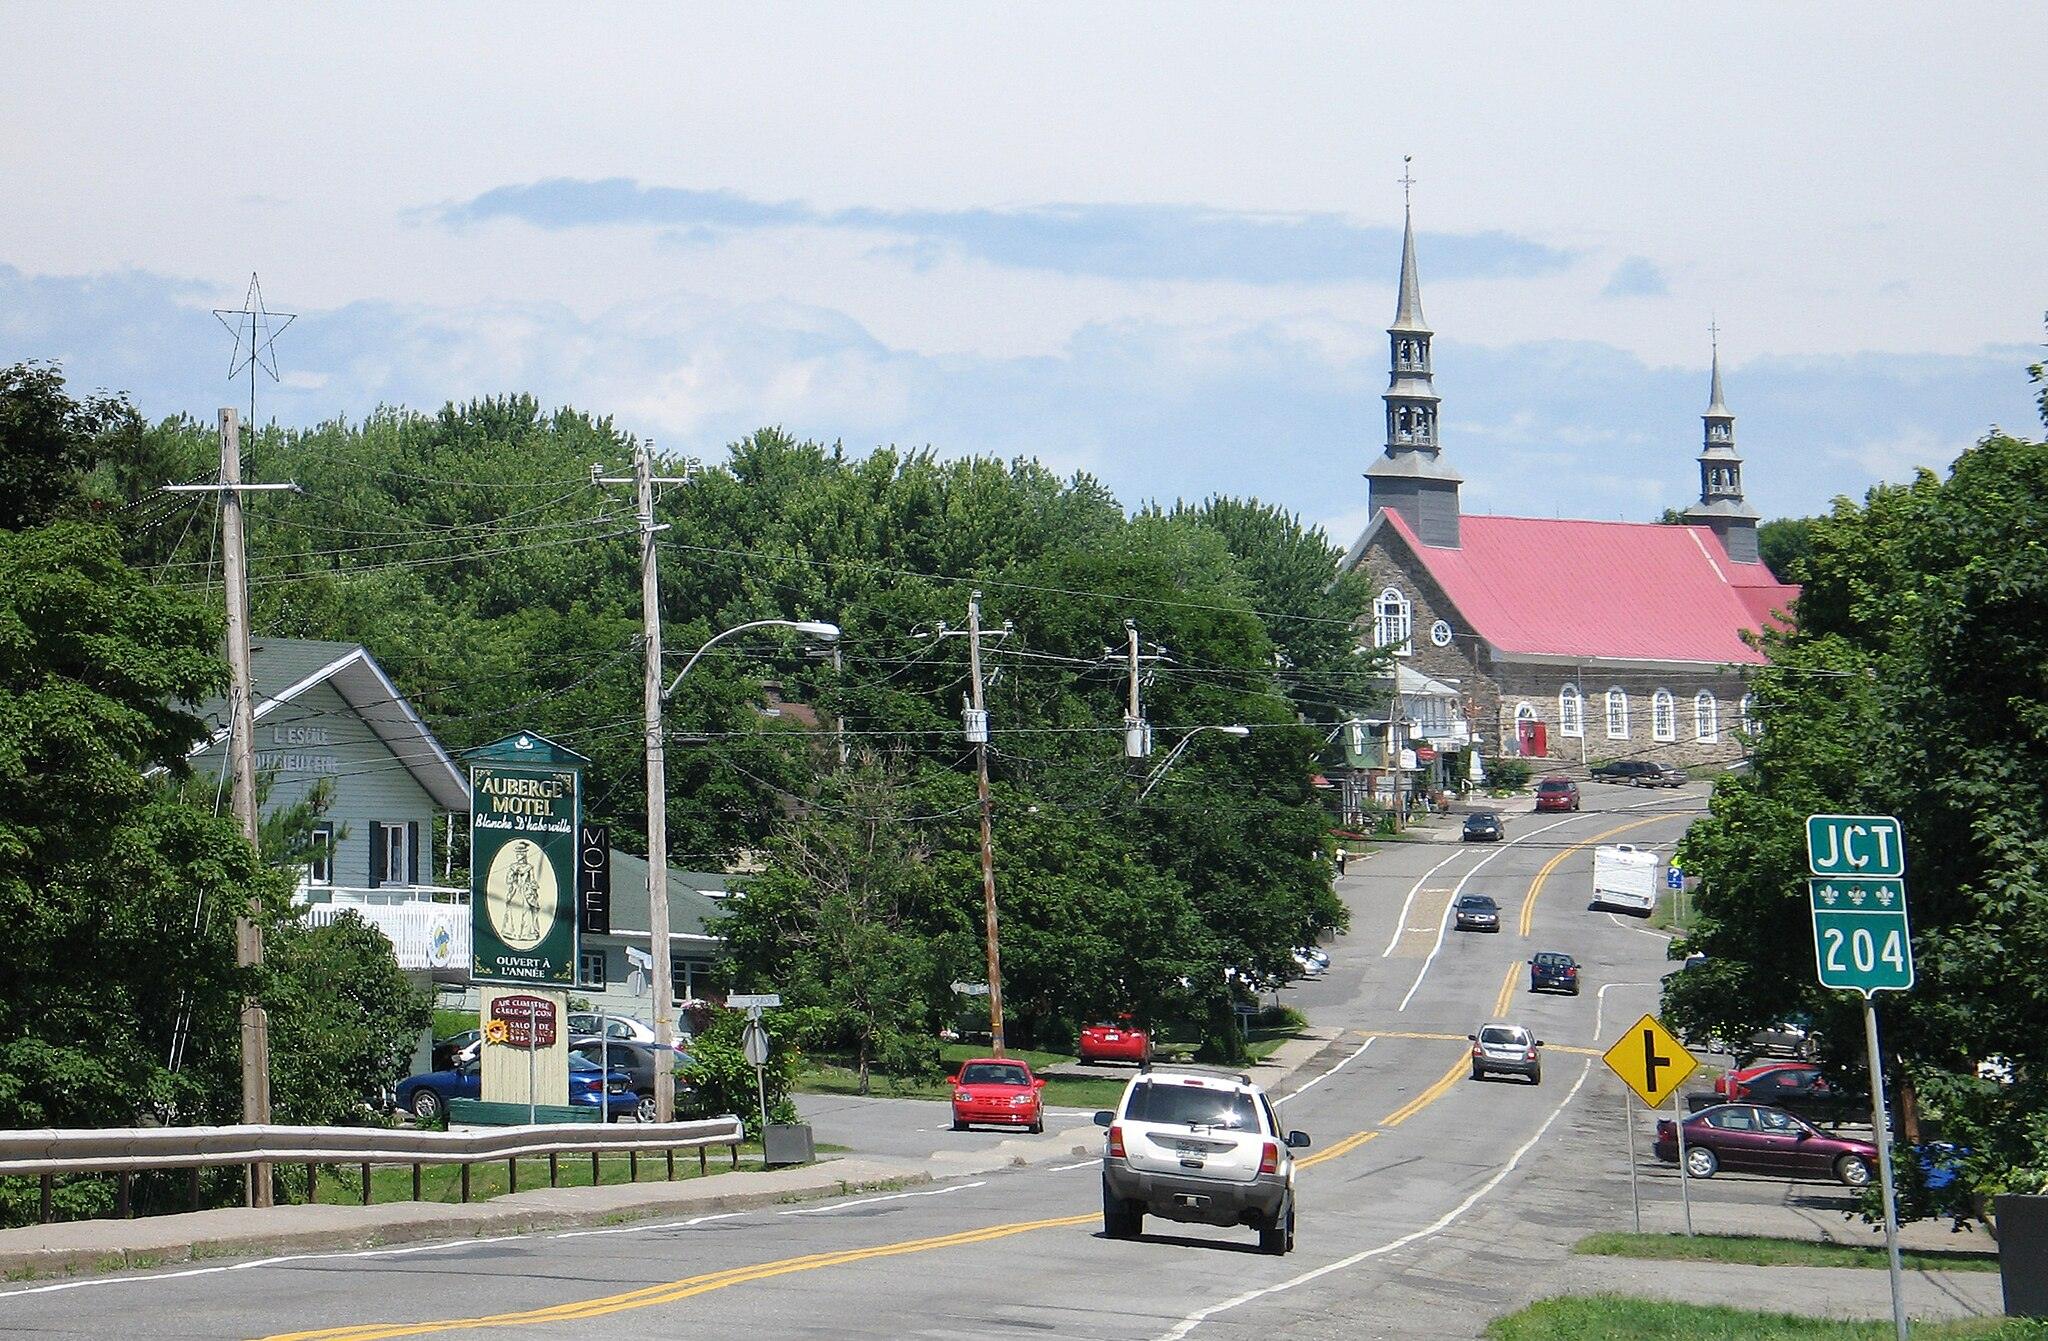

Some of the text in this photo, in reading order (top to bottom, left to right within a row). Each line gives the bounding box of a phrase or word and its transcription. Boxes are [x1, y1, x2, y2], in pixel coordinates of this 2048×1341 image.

[482, 777, 563, 798] AUBERGE
[493, 796, 554, 816] MOTEL
[475, 813, 513, 829] Blanche
[1817, 825, 1893, 867] JCT
[583, 828, 605, 931] MOTEL
[1823, 928, 1904, 972] 204
[496, 956, 551, 968] OUVERT À
[501, 966, 545, 978] L'ANNÉE
